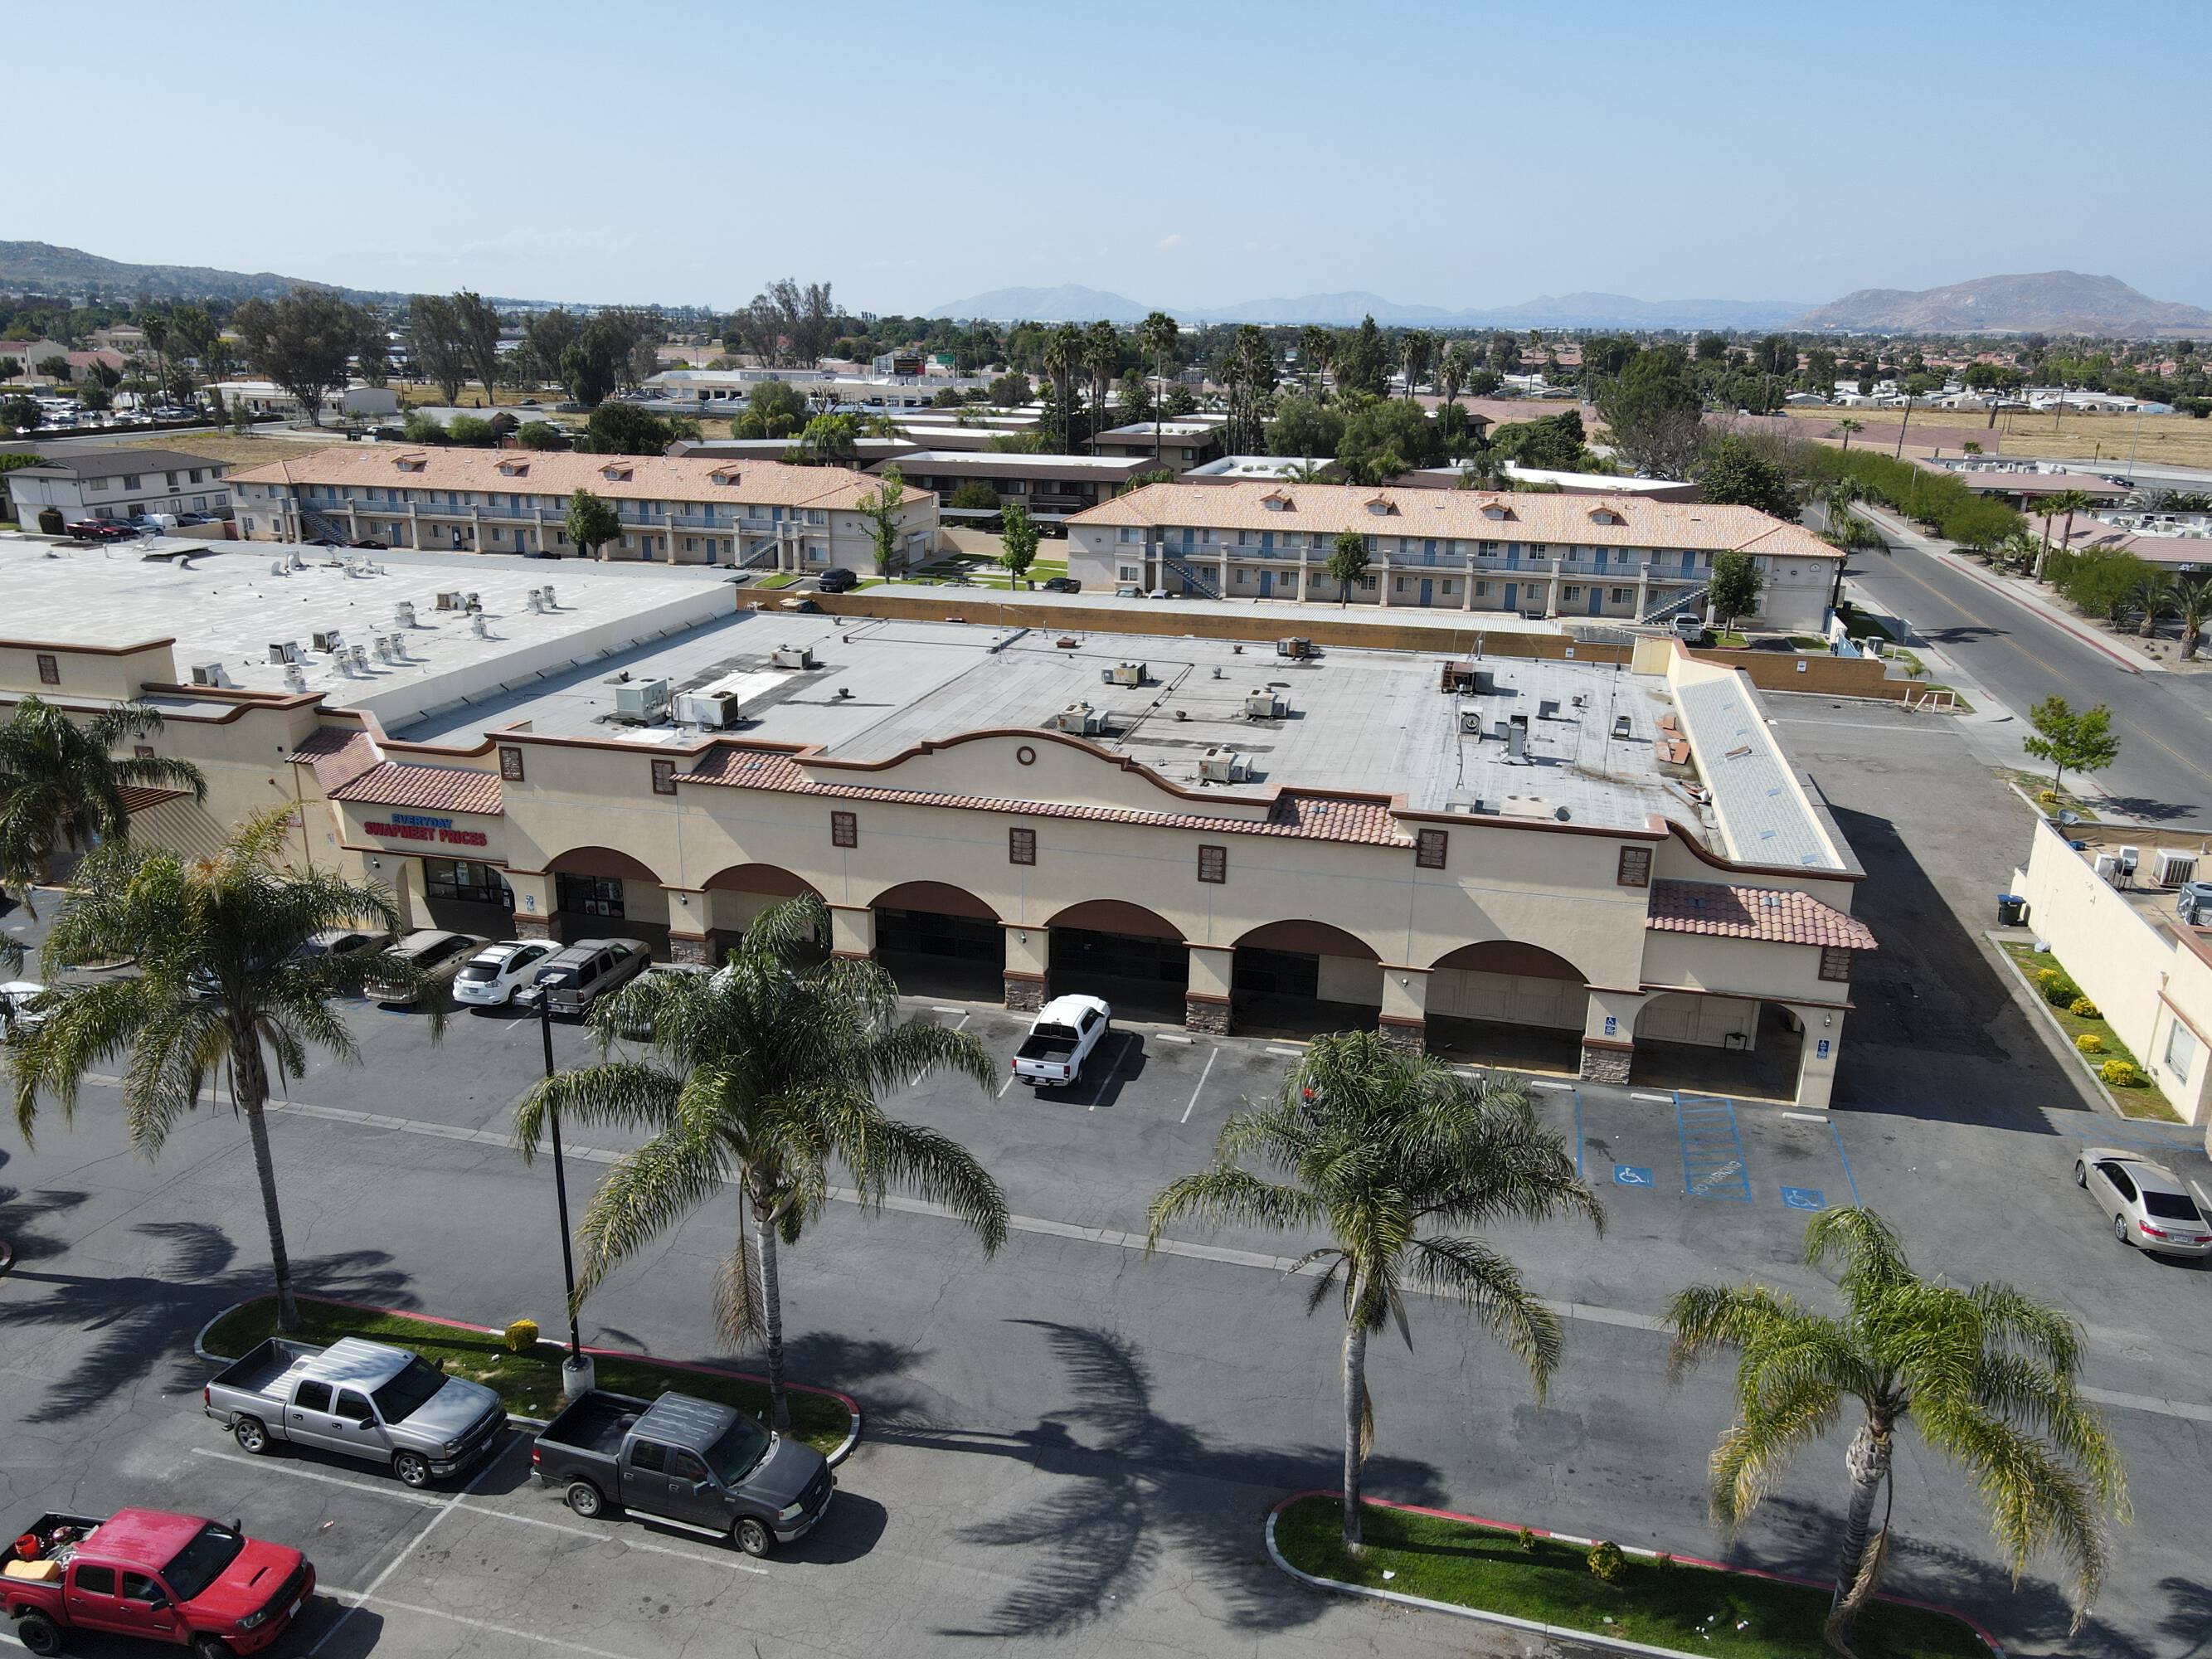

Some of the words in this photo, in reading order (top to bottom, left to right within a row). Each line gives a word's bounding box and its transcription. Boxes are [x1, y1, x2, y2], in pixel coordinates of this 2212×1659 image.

[391, 813, 454, 829] EVERYDAY
[363, 821, 435, 841] SWAPMEET
[439, 829, 488, 846] PRICES
